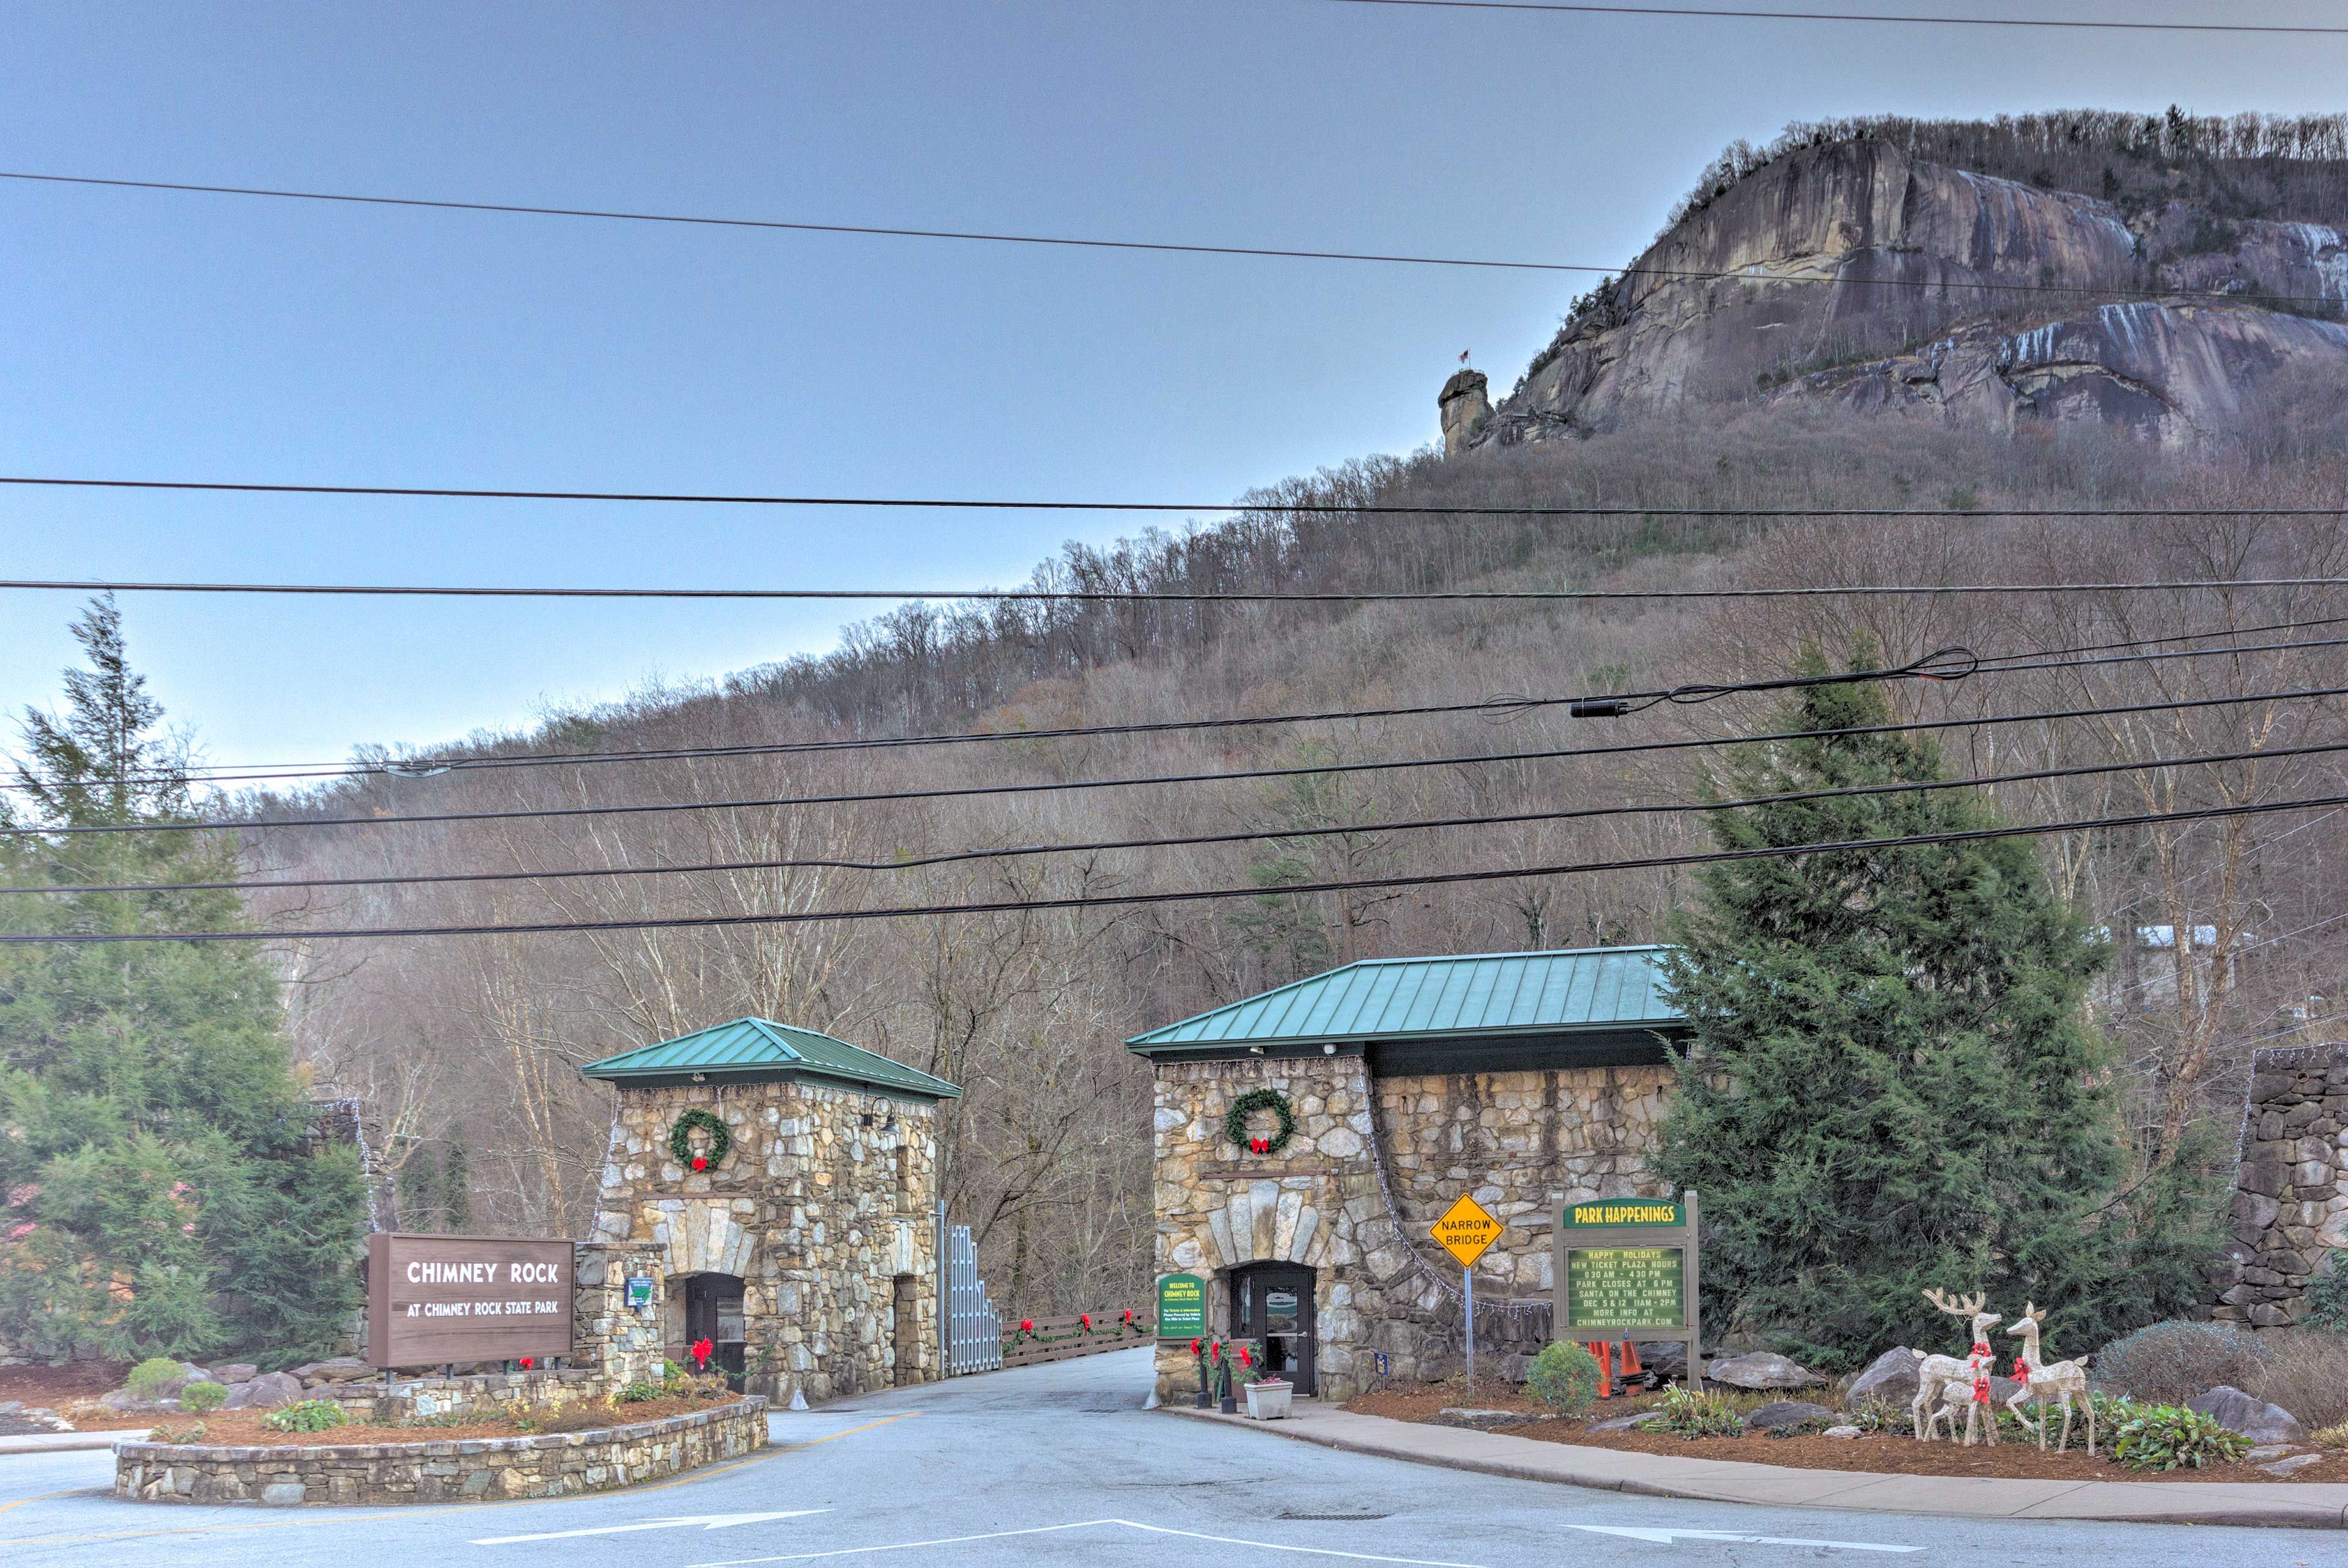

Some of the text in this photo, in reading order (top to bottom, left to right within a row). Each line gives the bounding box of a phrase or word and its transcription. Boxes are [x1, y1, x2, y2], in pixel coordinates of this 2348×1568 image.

[1575, 1205, 1675, 1223] PARK HAPPENINGS
[1442, 1220, 1491, 1230] NARROW
[1446, 1235, 1488, 1245] BRIDGE
[407, 1261, 558, 1284] CHIMNEY ROCK
[407, 1301, 558, 1317] AT CHIMNEY ROCK STATE PARK
